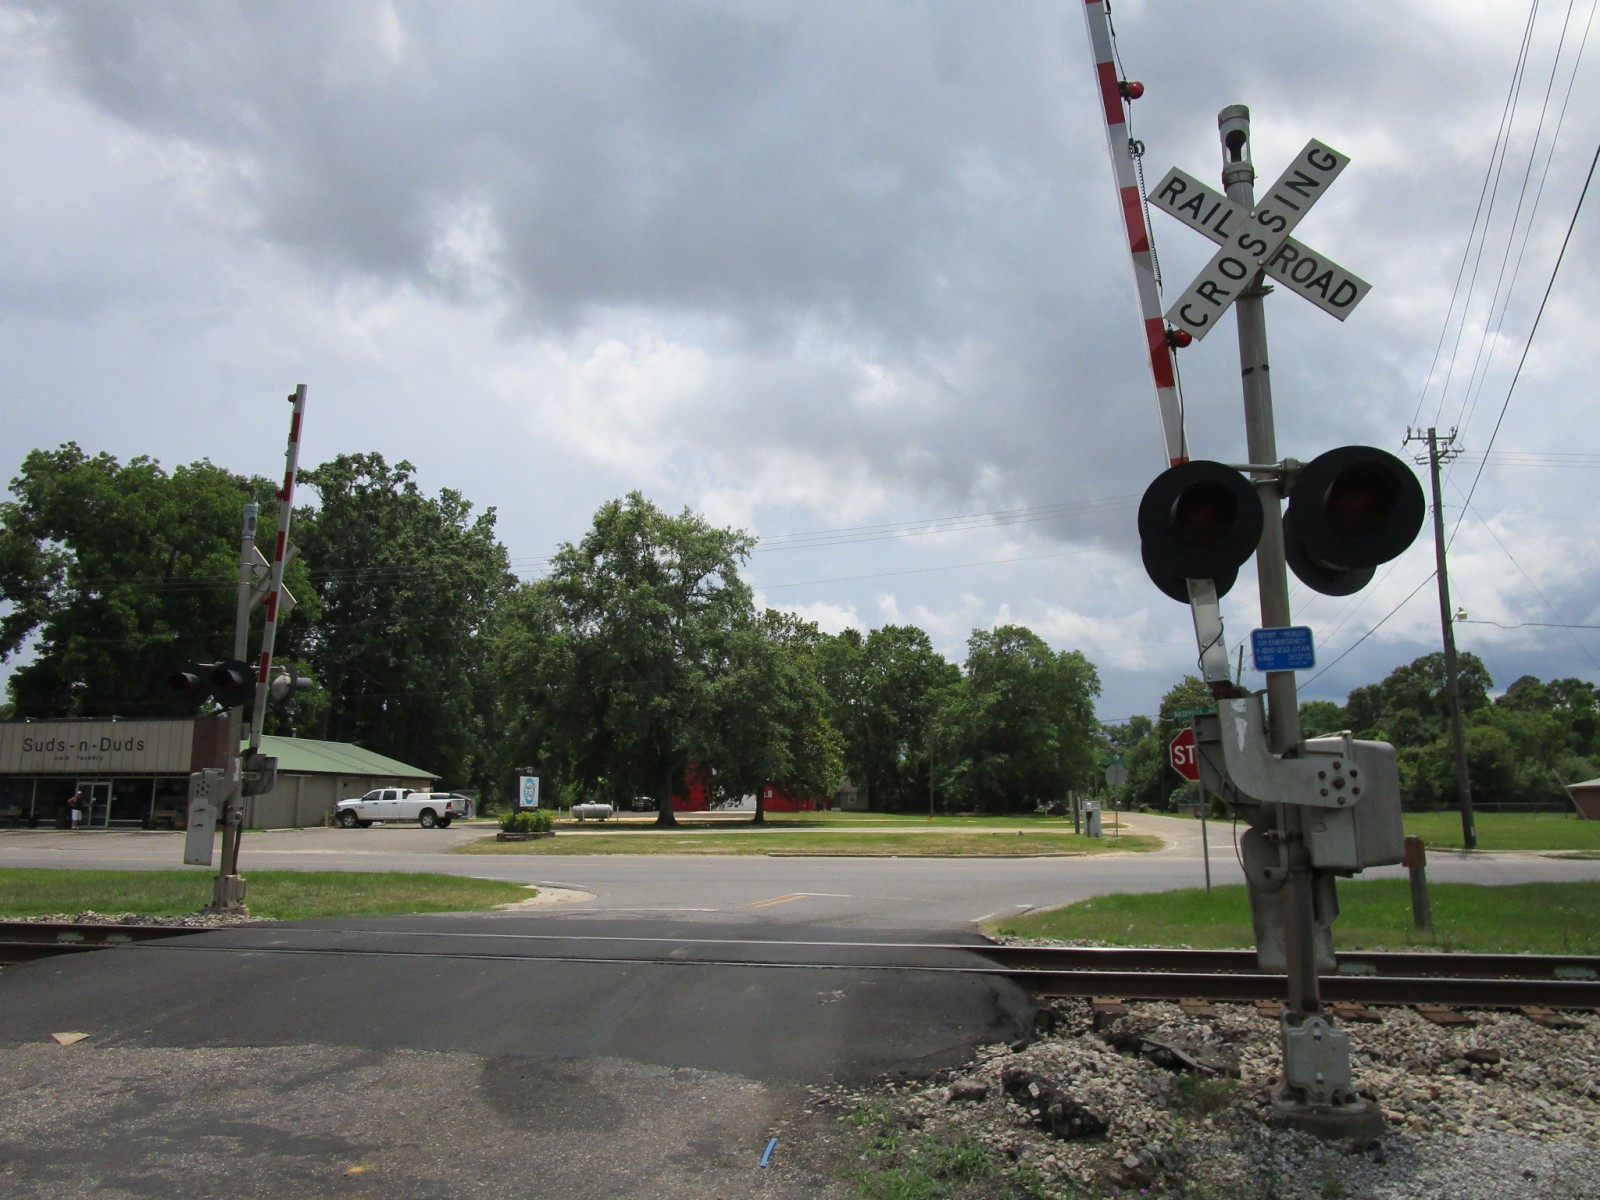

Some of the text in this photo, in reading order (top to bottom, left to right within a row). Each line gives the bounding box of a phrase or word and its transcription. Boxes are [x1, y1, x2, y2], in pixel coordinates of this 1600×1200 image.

[1157, 176, 1358, 308] RAIL ROAD
[1179, 148, 1338, 328] CROSSING
[1174, 744, 1195, 765] ST
